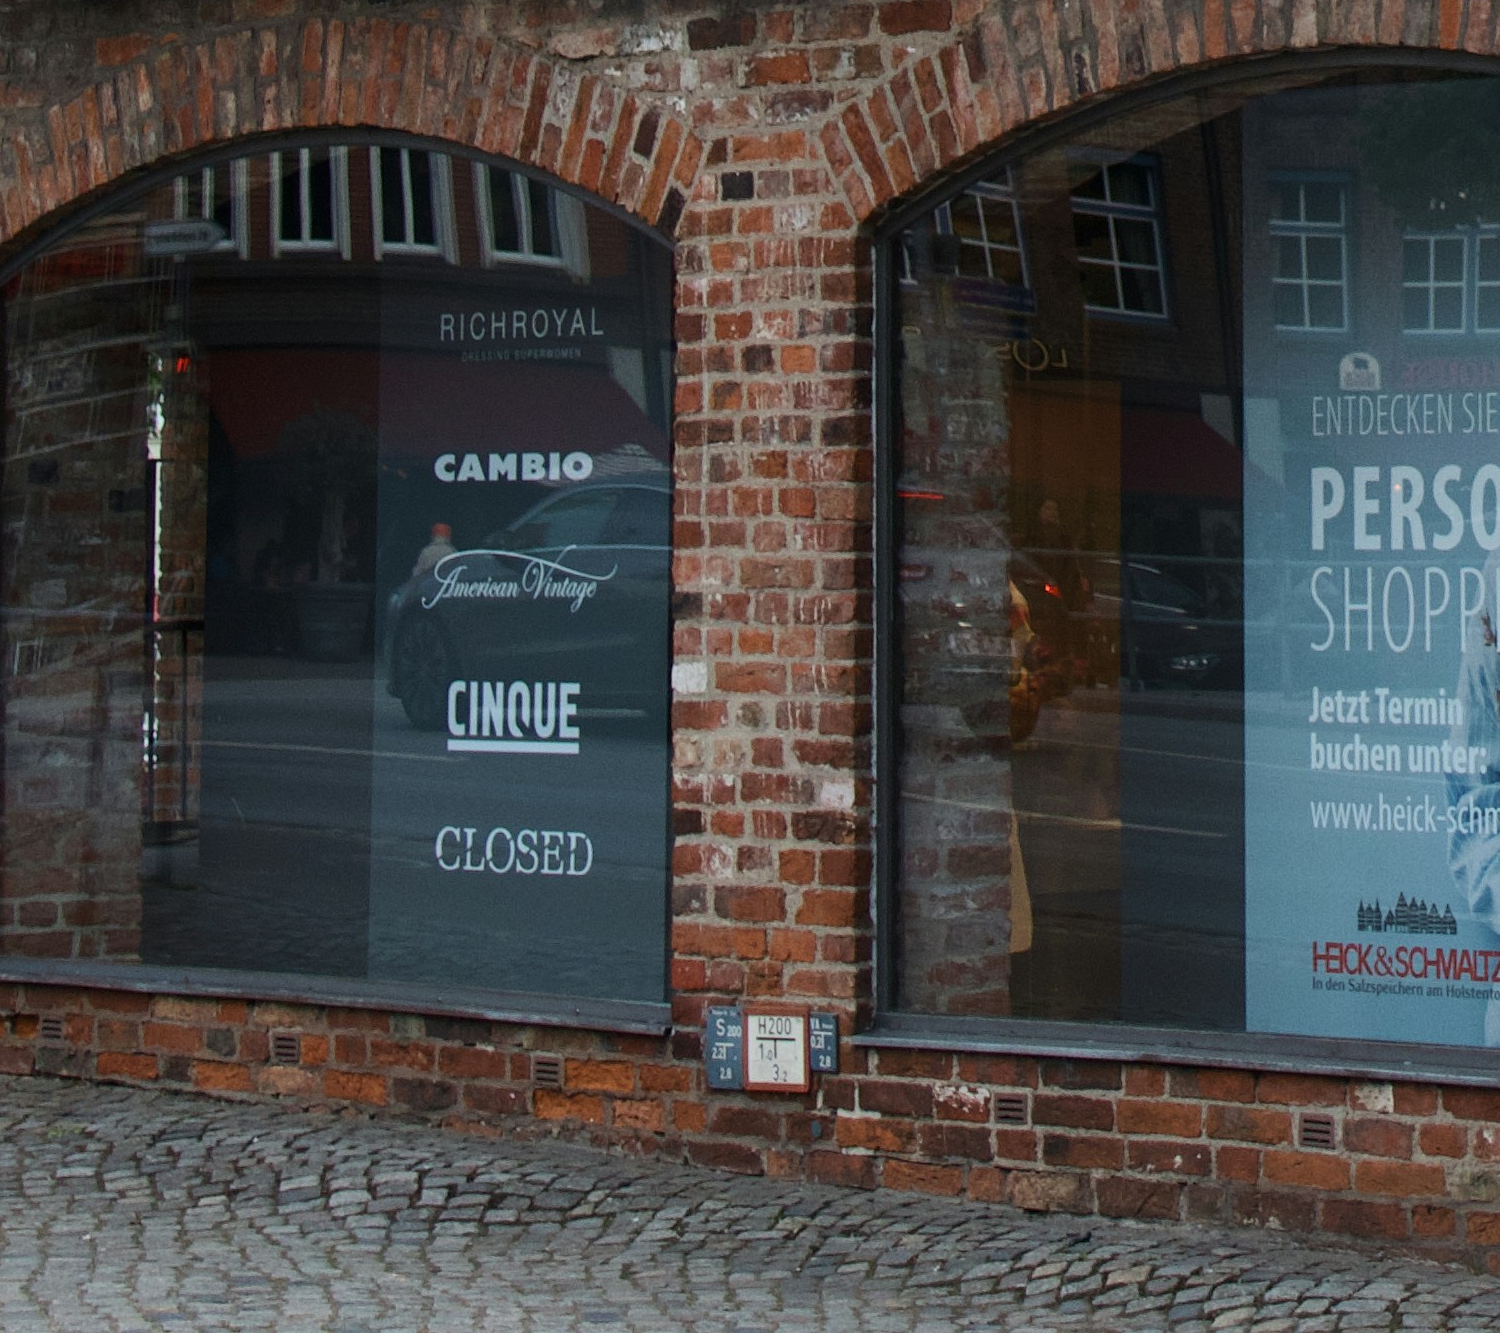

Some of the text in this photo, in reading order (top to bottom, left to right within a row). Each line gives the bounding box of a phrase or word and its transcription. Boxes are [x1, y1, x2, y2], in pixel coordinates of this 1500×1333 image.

[440, 307, 605, 341] RICHROYAL
[1312, 393, 1454, 436] ENTDECKEN
[1462, 391, 1499, 433] SIE
[434, 451, 594, 482] CAMBIO
[422, 545, 604, 613] American Vintage
[448, 680, 580, 739] CINQUE
[1309, 686, 1463, 726] Jetzt Termin
[1310, 732, 1488, 774] buchen unter:
[435, 826, 594, 876] CLOSED
[1312, 975, 1323, 990] In
[1325, 978, 1346, 992] den
[1349, 978, 1424, 998] Salzspeichern
[1426, 983, 1443, 997] am
[716, 1018, 726, 1037] S
[758, 1017, 792, 1035] H200
